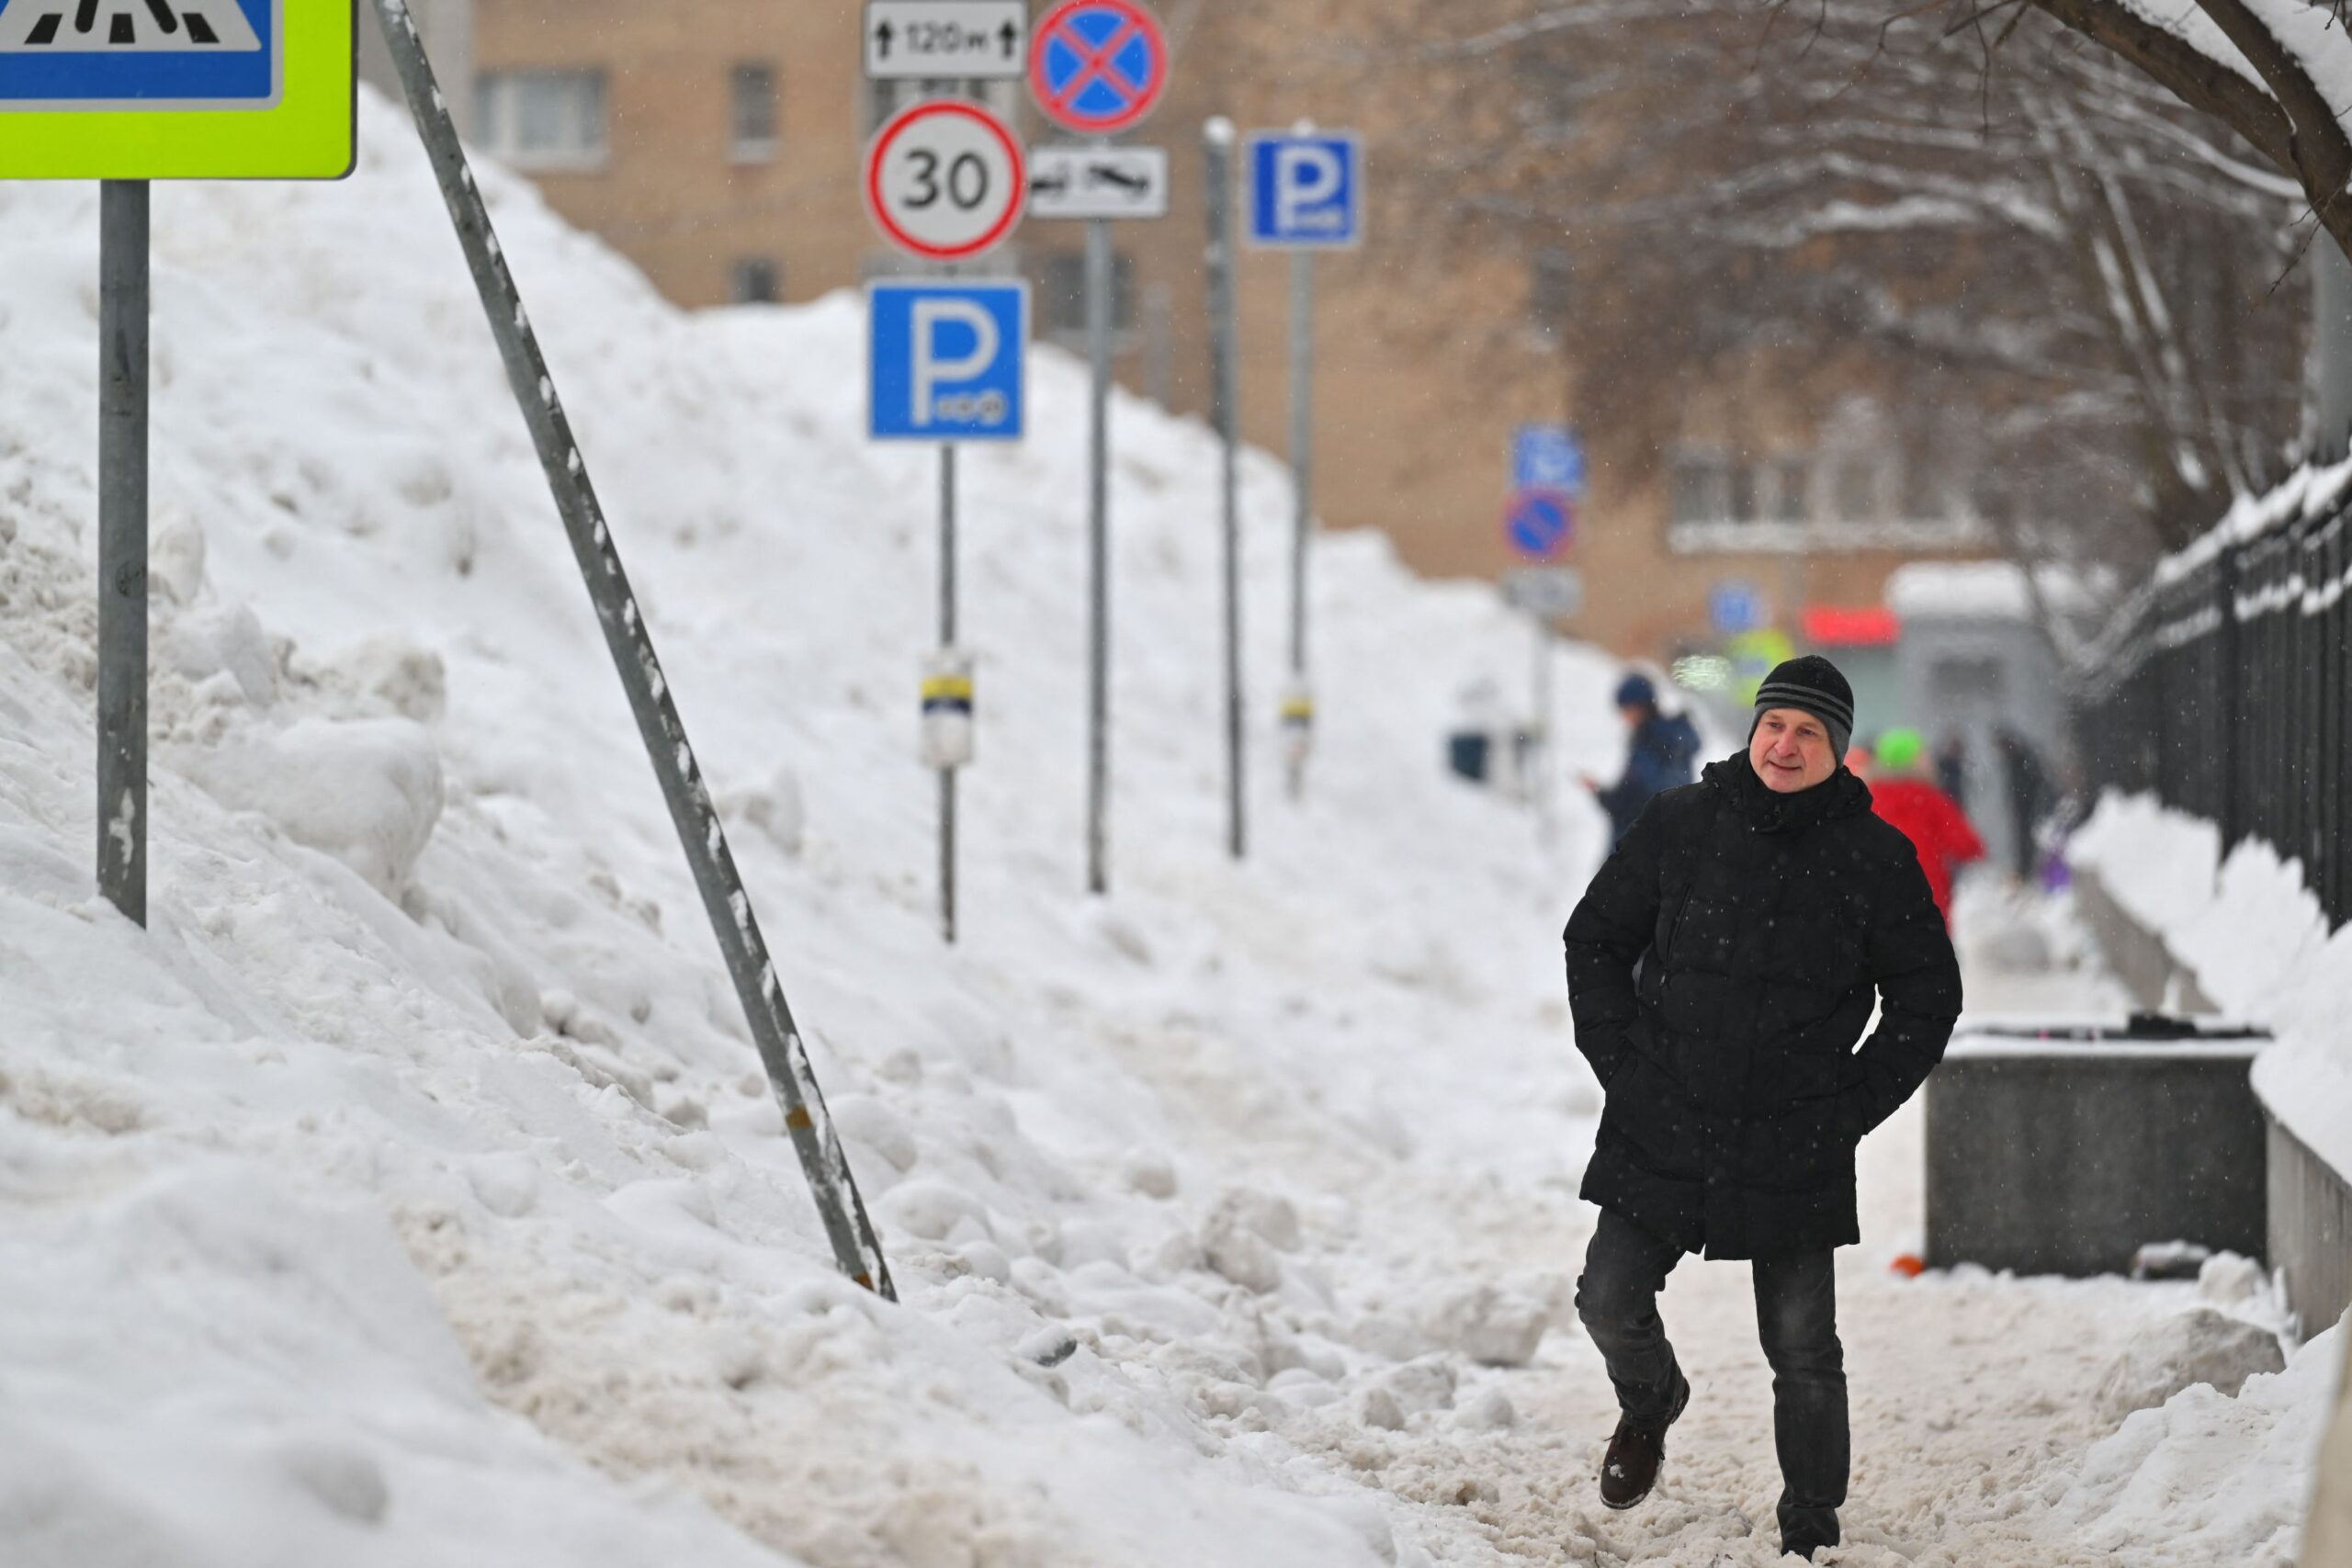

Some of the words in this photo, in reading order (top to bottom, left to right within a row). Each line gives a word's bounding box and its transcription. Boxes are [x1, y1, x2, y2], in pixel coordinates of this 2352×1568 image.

[901, 148, 989, 211] 30
[1276, 145, 1341, 230] P
[910, 298, 1000, 427] P
